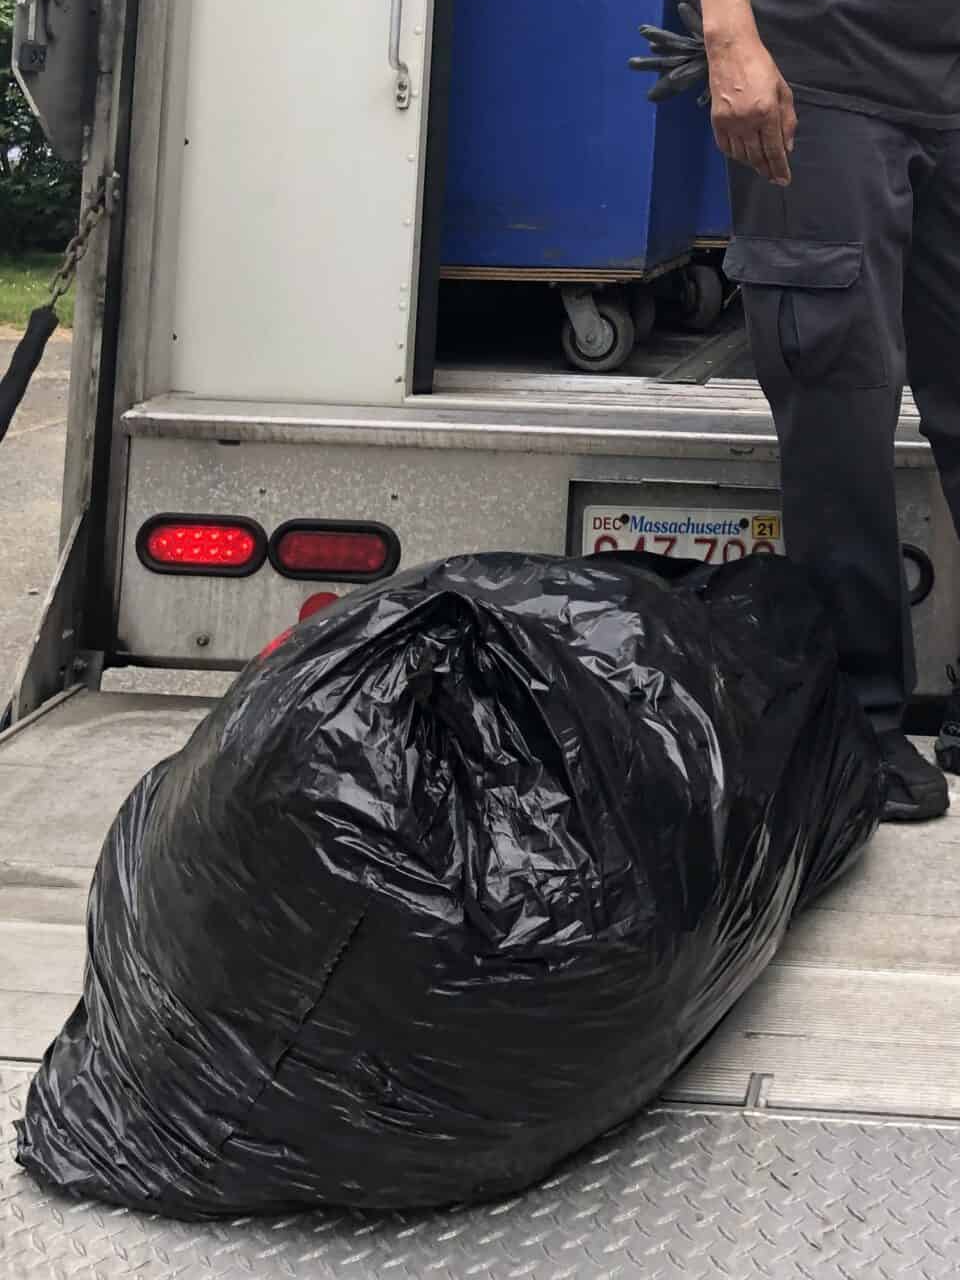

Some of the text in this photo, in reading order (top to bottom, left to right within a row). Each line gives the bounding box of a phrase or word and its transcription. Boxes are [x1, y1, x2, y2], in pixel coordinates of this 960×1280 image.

[592, 515, 742, 536] DEC Massachusetts
[757, 522, 774, 537] 21
